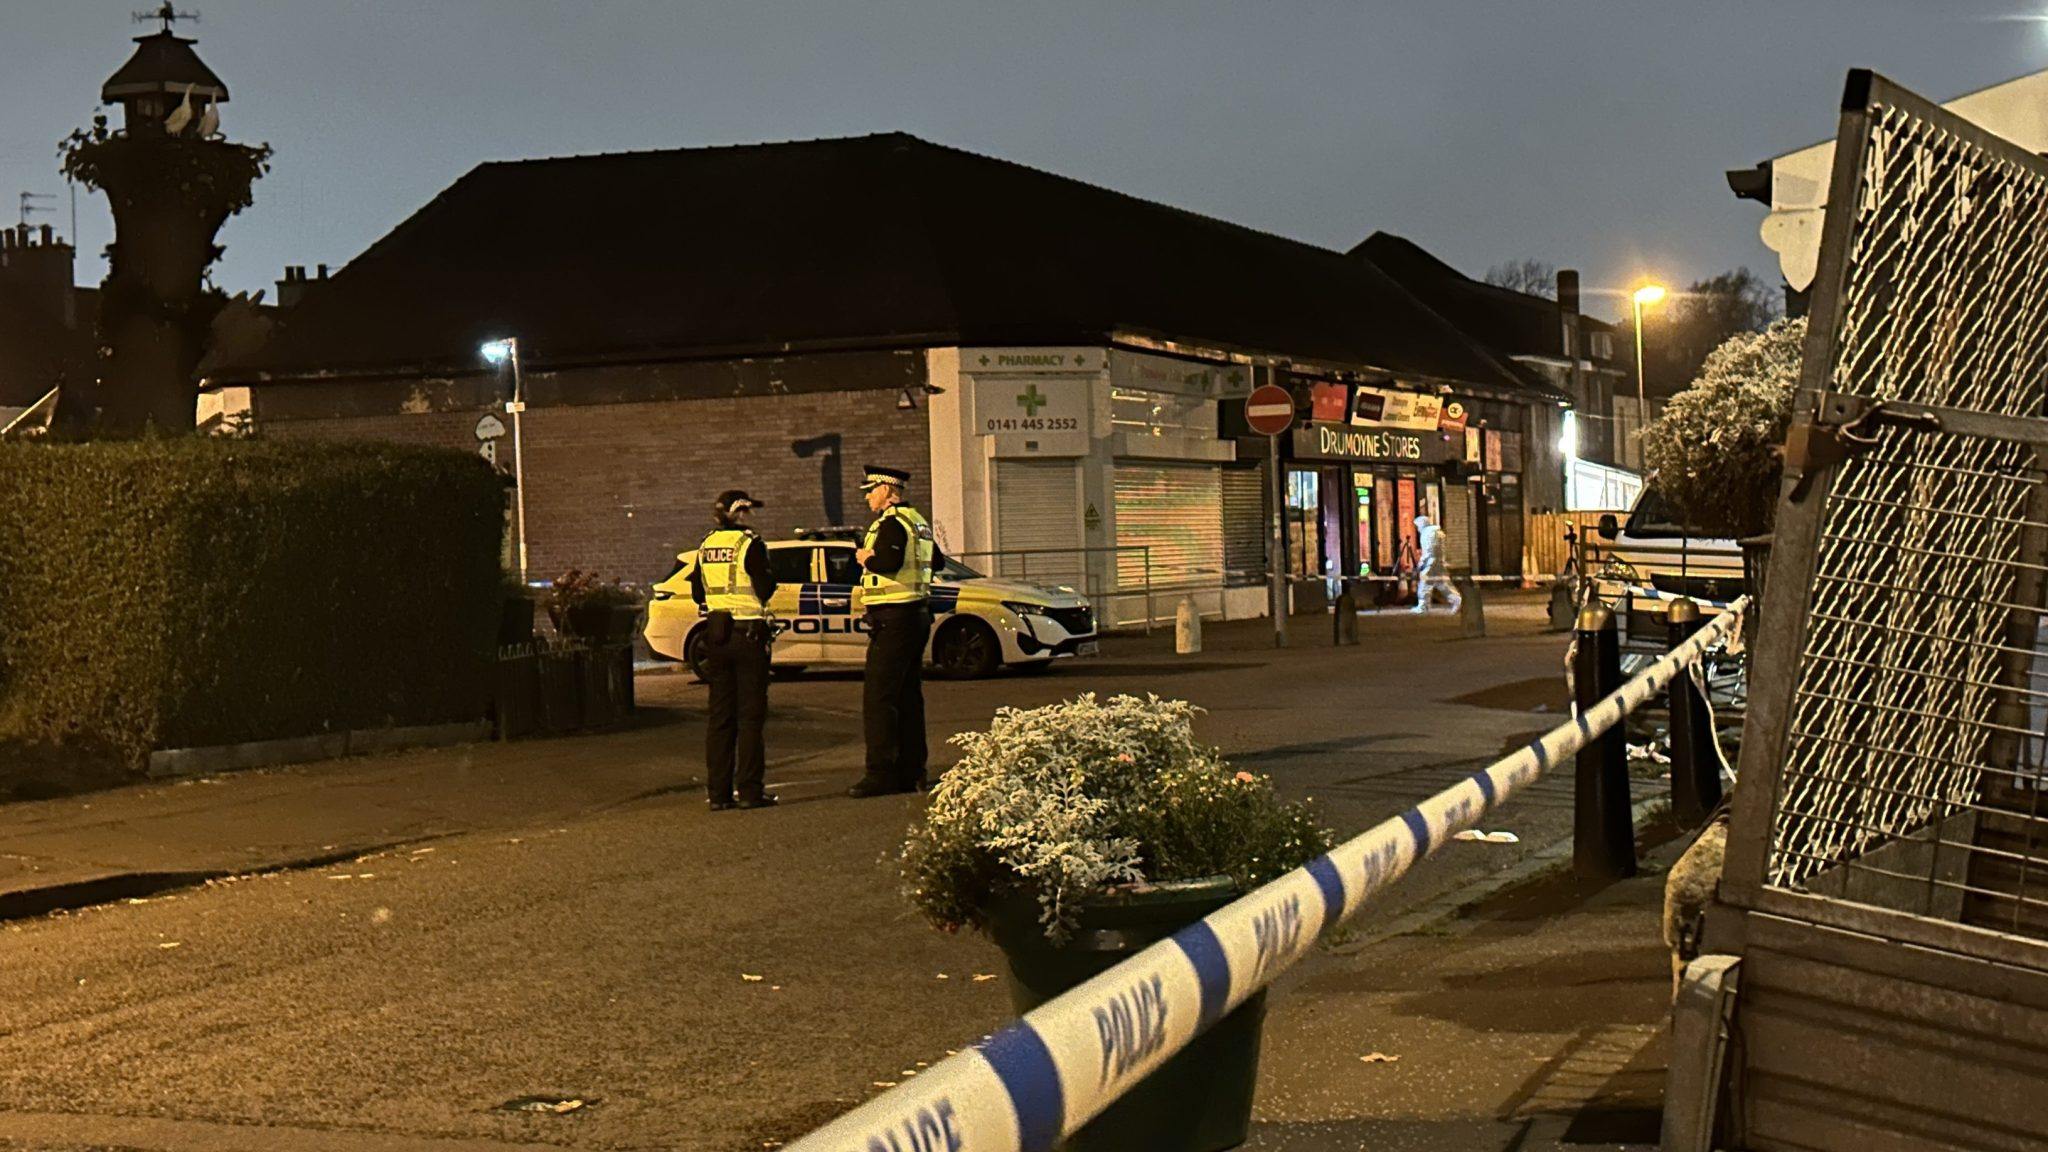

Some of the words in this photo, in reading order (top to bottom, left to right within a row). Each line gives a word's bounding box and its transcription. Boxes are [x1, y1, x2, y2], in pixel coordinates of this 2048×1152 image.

[998, 355, 1065, 366] PHARMACY
[987, 419, 1017, 430] 0141
[1021, 419, 1044, 430] 445
[1047, 419, 1077, 430] 2552
[1320, 426, 1380, 458] DRUMOYNE
[1382, 431, 1420, 459] STORES
[774, 618, 873, 634] POLIC
